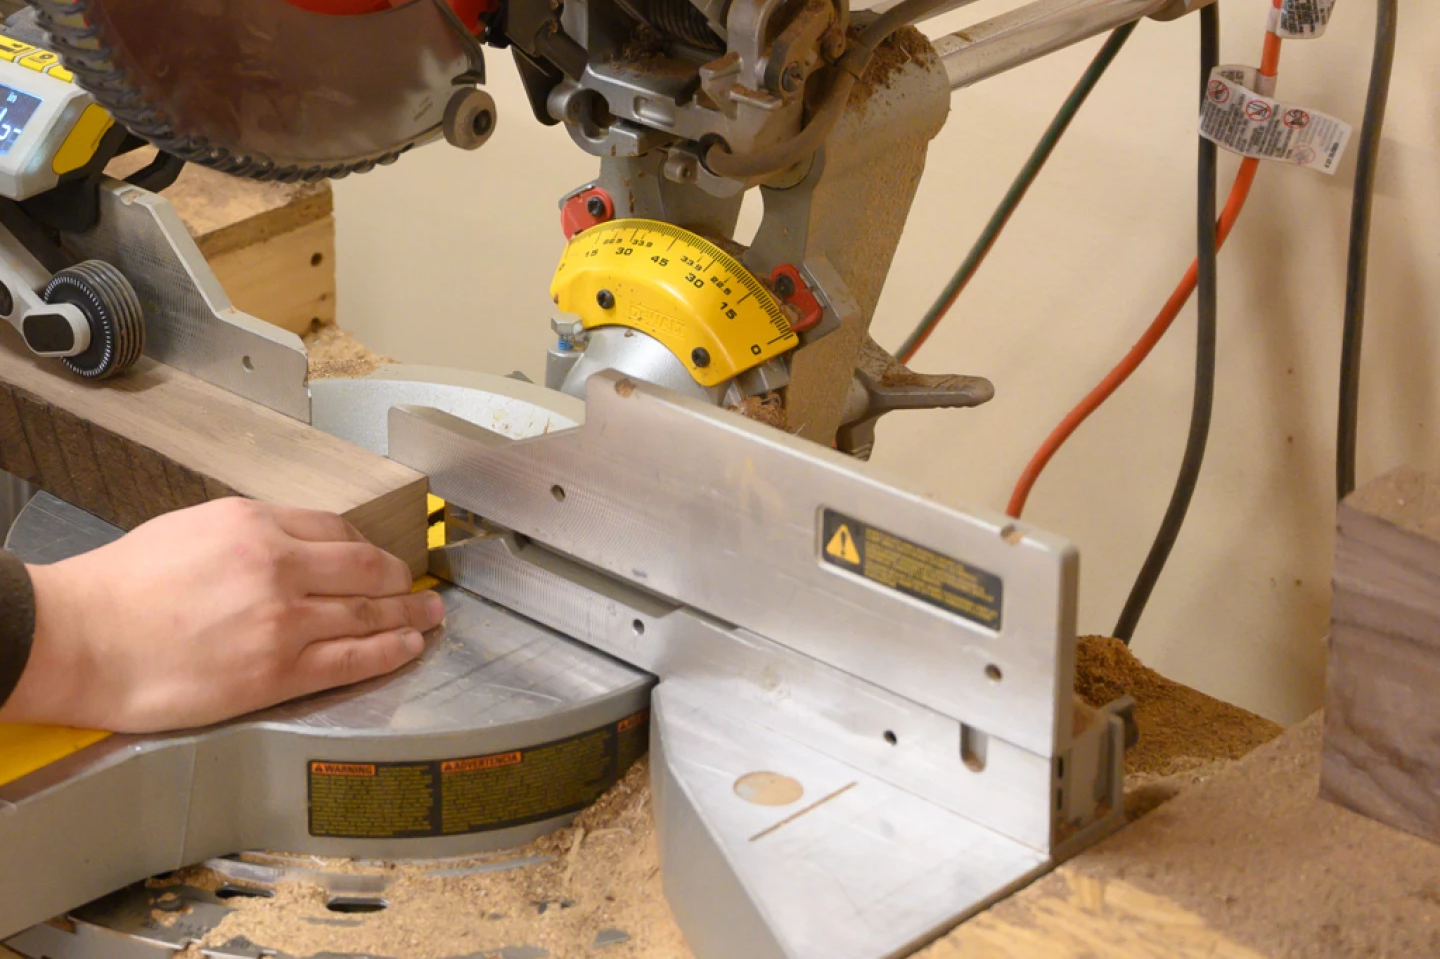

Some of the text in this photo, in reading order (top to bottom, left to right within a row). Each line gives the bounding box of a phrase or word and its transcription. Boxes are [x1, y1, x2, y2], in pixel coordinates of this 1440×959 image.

[615, 246, 633, 256] 30
[650, 254, 669, 267] 45
[684, 272, 705, 289] 30
[709, 275, 732, 296] 22.5
[720, 301, 738, 320] 15
[750, 344, 762, 356] 0
[324, 763, 372, 774] WARNING
